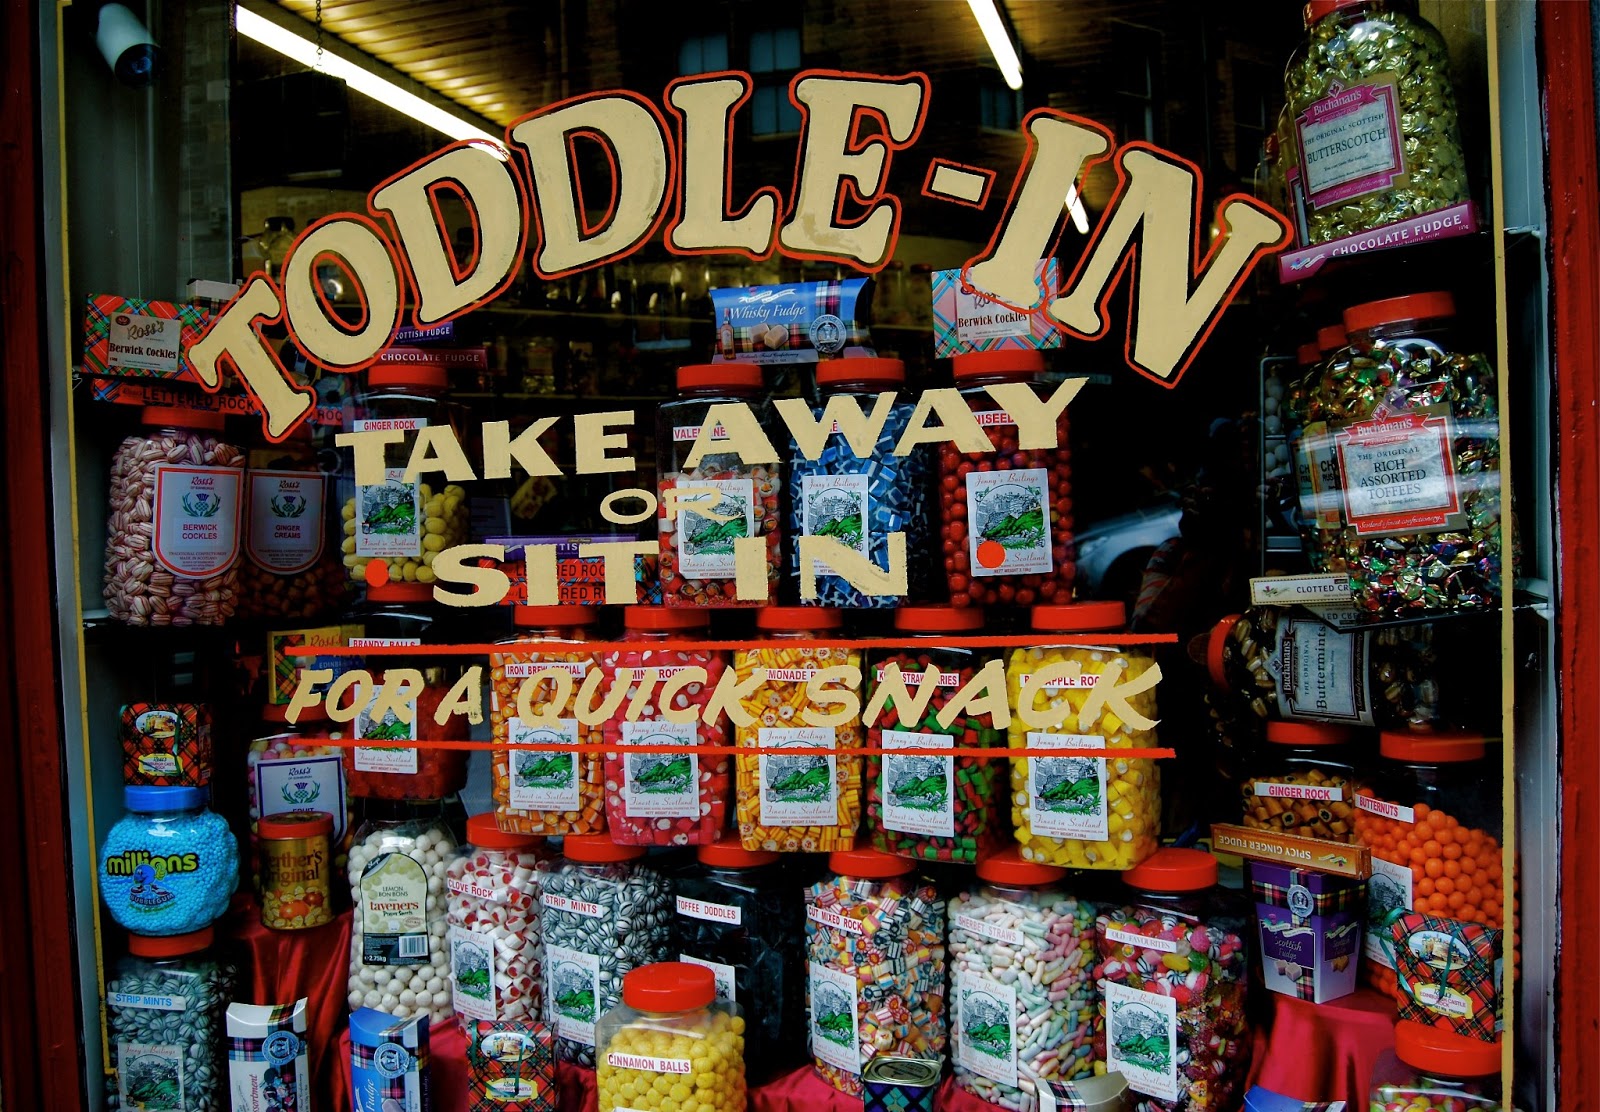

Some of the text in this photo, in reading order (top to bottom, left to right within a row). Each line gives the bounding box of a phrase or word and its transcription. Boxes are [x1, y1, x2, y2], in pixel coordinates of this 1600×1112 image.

[1313, 88, 1363, 117] Buchanan's
[1304, 137, 1316, 148] THE
[1315, 126, 1345, 144] ORIGINAL
[1347, 112, 1386, 131] SCOTTISH
[1307, 126, 1388, 166] BUTTERSCOTCH
[1332, 217, 1463, 257] CHOCOLATE FUDGE
[190, 69, 1294, 441] TODDLE-IN
[729, 301, 808, 324] Whisky Fudge
[958, 311, 1027, 328] Berwick Cockles
[426, 326, 451, 339] FUDGE
[109, 341, 177, 360] Berwick Cockles
[381, 352, 481, 364] CHOCOLATE FUDGE
[142, 389, 214, 408] LETTERED
[218, 395, 255, 412] ROCK
[335, 377, 1090, 487] TAKE AWAY
[364, 420, 417, 432] GINGER ROCK
[674, 425, 728, 440] VALENE
[1357, 418, 1413, 437] Buchanan's
[1358, 446, 1421, 461] THE ORIGINAL
[1373, 458, 1407, 474] RICH
[974, 472, 1040, 487] Jenny's Boilings
[1359, 468, 1427, 489] ASSORTED
[1367, 483, 1422, 502] TOFFEES
[600, 487, 745, 524] OR
[182, 523, 218, 532] BERWICK
[182, 531, 218, 540] COCKLES
[274, 531, 302, 539] CREAMS
[275, 524, 301, 532] GINGER
[1012, 551, 1047, 564] Scotland
[433, 531, 908, 608] SIT IN
[582, 563, 605, 578] ROC
[1296, 584, 1335, 594] CLOTTED
[354, 639, 385, 648] BRANDY
[507, 665, 525, 677] IRON
[1282, 640, 1291, 692] Buchanan's
[1315, 625, 1328, 710] Buttermints
[766, 669, 807, 682] MONADE
[902, 672, 958, 687] STRARIES
[1080, 674, 1100, 687] ROC
[285, 658, 1164, 731] FOR A QUICK SNACK
[629, 723, 689, 737] Jenny's Boilings
[766, 729, 828, 741] Jenny's Boilings
[888, 733, 945, 749] Jenny's Boilings
[1035, 736, 1097, 749] Jenny's Boilings
[514, 790, 536, 802] Finest
[544, 790, 574, 802] Scotland
[1268, 785, 1331, 800] GINGER ROCK
[629, 796, 654, 808] Finest
[664, 796, 694, 808] Scotland
[764, 802, 832, 816] Finest in Scotland
[1359, 796, 1399, 818] BUTTERNUTS
[886, 808, 907, 822] Finest
[917, 813, 949, 826] Scotland
[1034, 813, 1103, 830] Finest in Scotland
[1218, 834, 1312, 861] SPICY GINGER FUDGE
[107, 850, 199, 877] millions
[392, 890, 409, 898] BONS
[448, 879, 495, 898] CLOVE ROCK
[129, 892, 175, 908] BUBBLEGUM
[370, 901, 420, 911] taveners
[545, 894, 598, 914] STRIP MINTS
[677, 900, 737, 920] TOFFEE DODDLES
[808, 907, 863, 932] CUT MIXED ROCK
[958, 915, 1017, 942] SHERBET STRAWS
[1111, 930, 1171, 949] OLD FAVOURITES
[1275, 932, 1303, 953] Scottish
[116, 993, 173, 1007] STRIP MINTS
[1111, 985, 1167, 1010] Jenny's Boilings
[608, 1054, 690, 1073] CINNAMON BALLS
[1142, 1073, 1172, 1088] Scotland
[250, 1073, 258, 1112] ssortment
